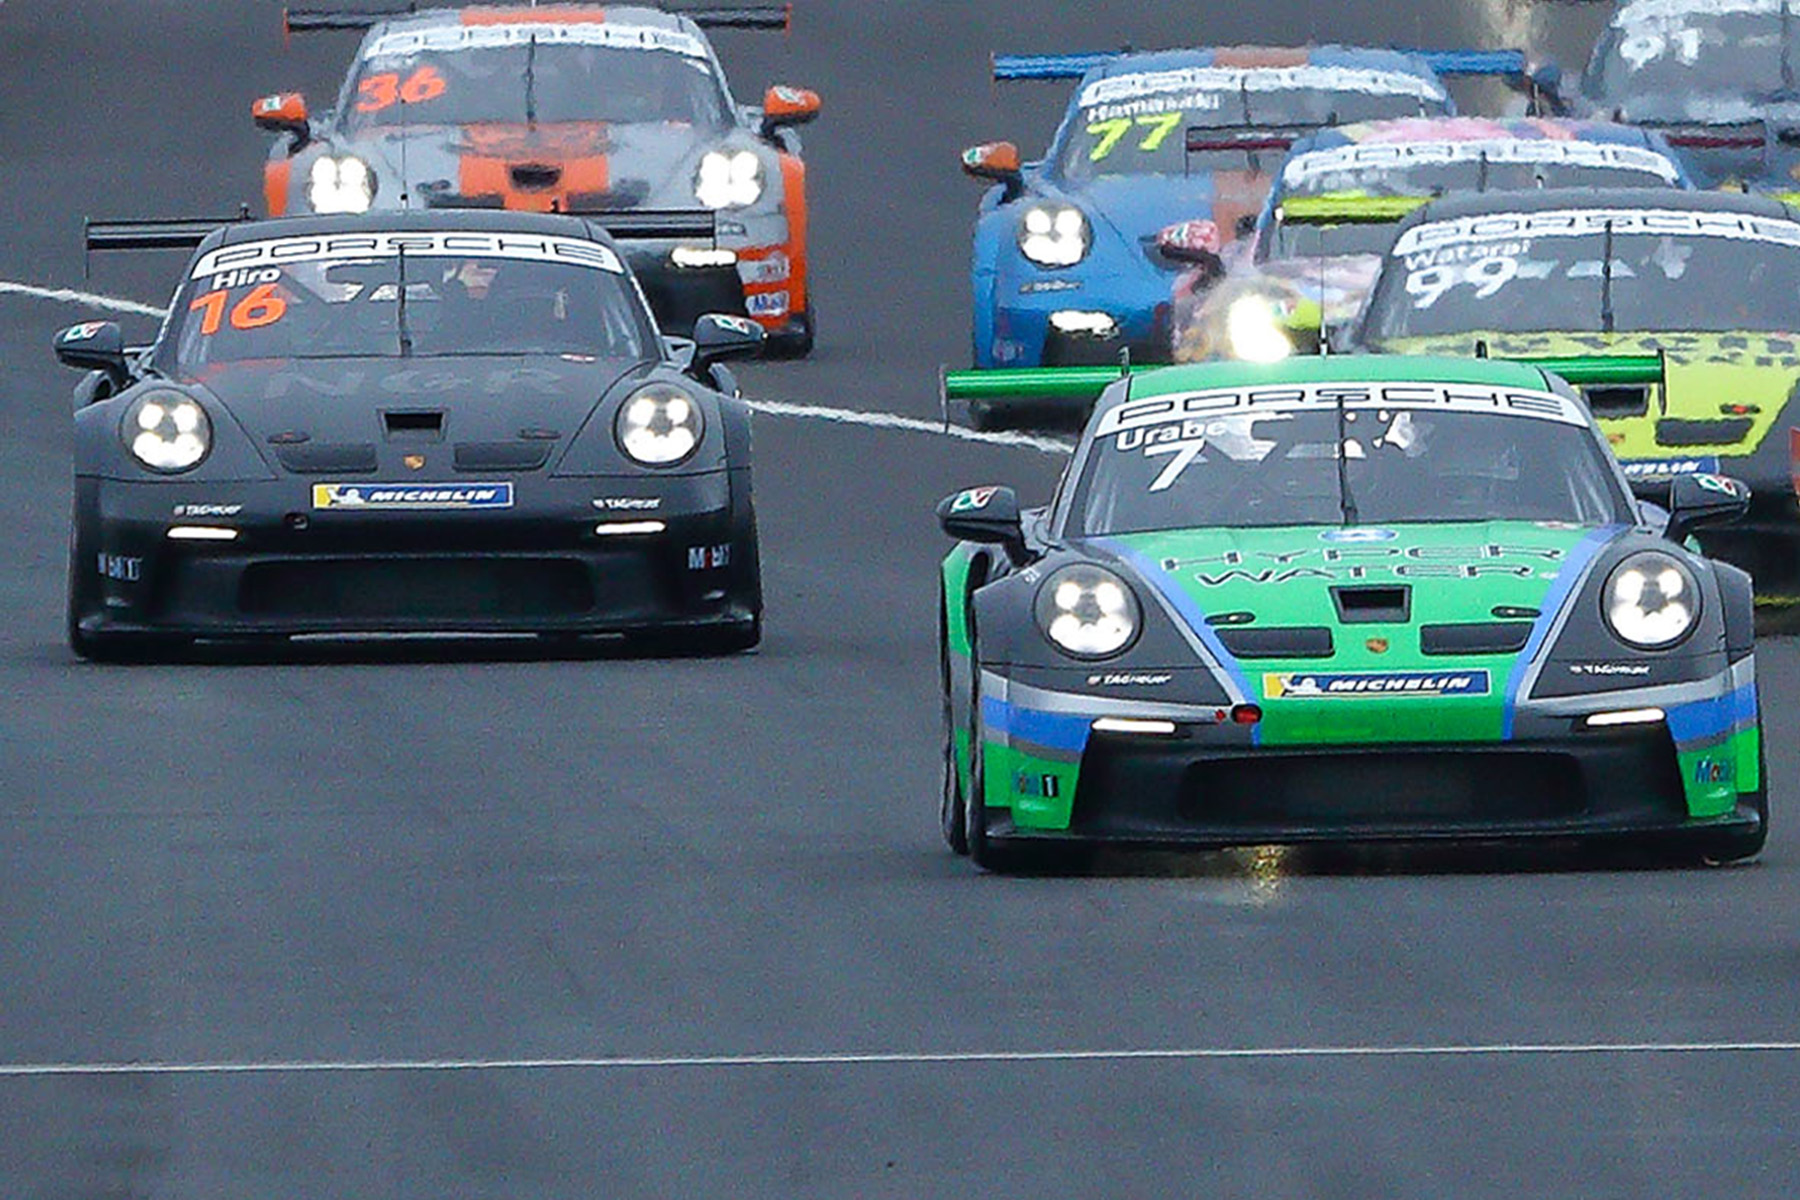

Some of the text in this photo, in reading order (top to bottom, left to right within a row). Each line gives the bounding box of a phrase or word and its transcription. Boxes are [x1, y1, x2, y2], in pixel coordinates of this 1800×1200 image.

[356, 65, 446, 113] 36
[1087, 112, 1183, 163] 77
[212, 236, 606, 268] PORSCHE
[212, 265, 281, 291] Hiro
[1405, 256, 1519, 309] 99
[190, 283, 288, 336] 16
[1117, 386, 1566, 424] PORSCHE
[1115, 418, 1226, 452] Urabe
[1143, 437, 1206, 492] 7
[369, 488, 499, 504] MICHELIN
[1161, 543, 1566, 571] HYPER
[1195, 563, 1534, 586] WATER
[1329, 676, 1473, 694] MICHELIN
